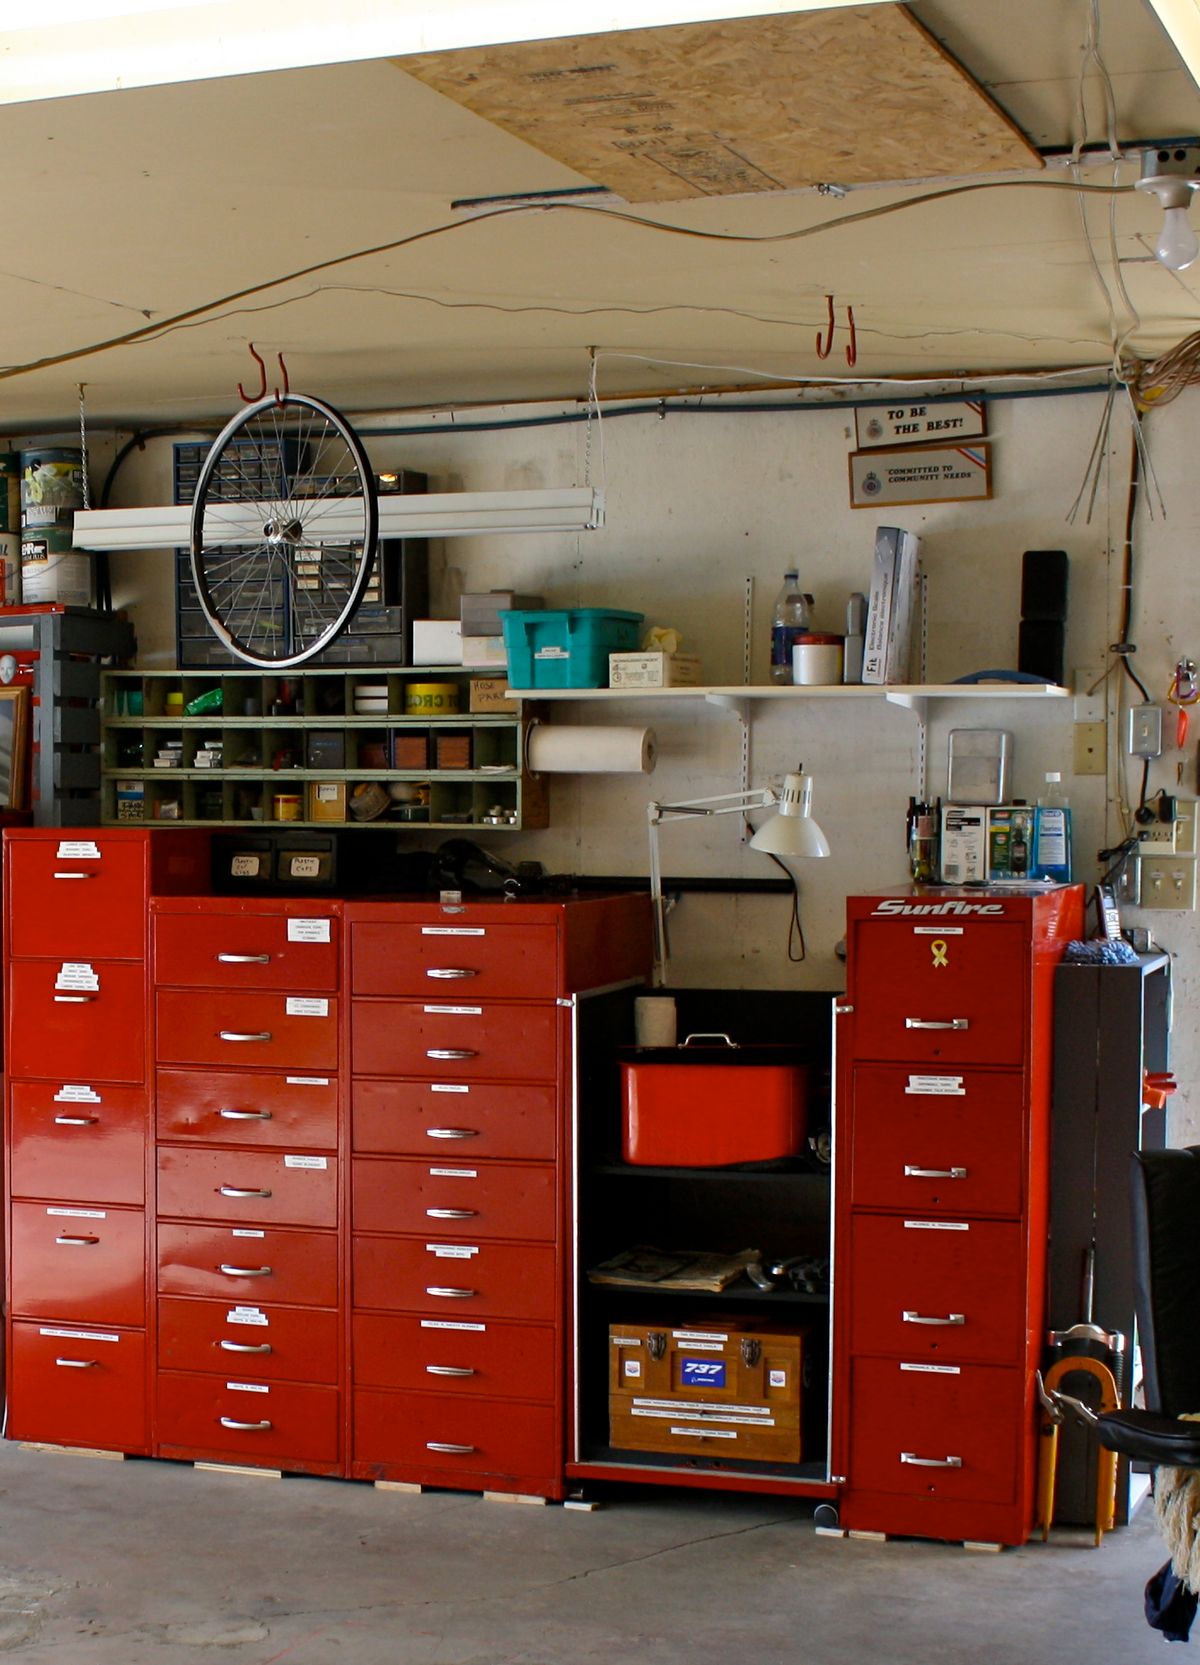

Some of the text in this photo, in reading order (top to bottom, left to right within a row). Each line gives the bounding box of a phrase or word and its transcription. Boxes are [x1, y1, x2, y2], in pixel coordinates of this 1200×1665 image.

[888, 407, 927, 420] TO BE
[894, 418, 964, 435] THE BEST!
[942, 464, 953, 474] TO
[888, 473, 940, 483] COMMUNITY
[871, 899, 1005, 916] Sunfire
[684, 1362, 723, 1376] 737
